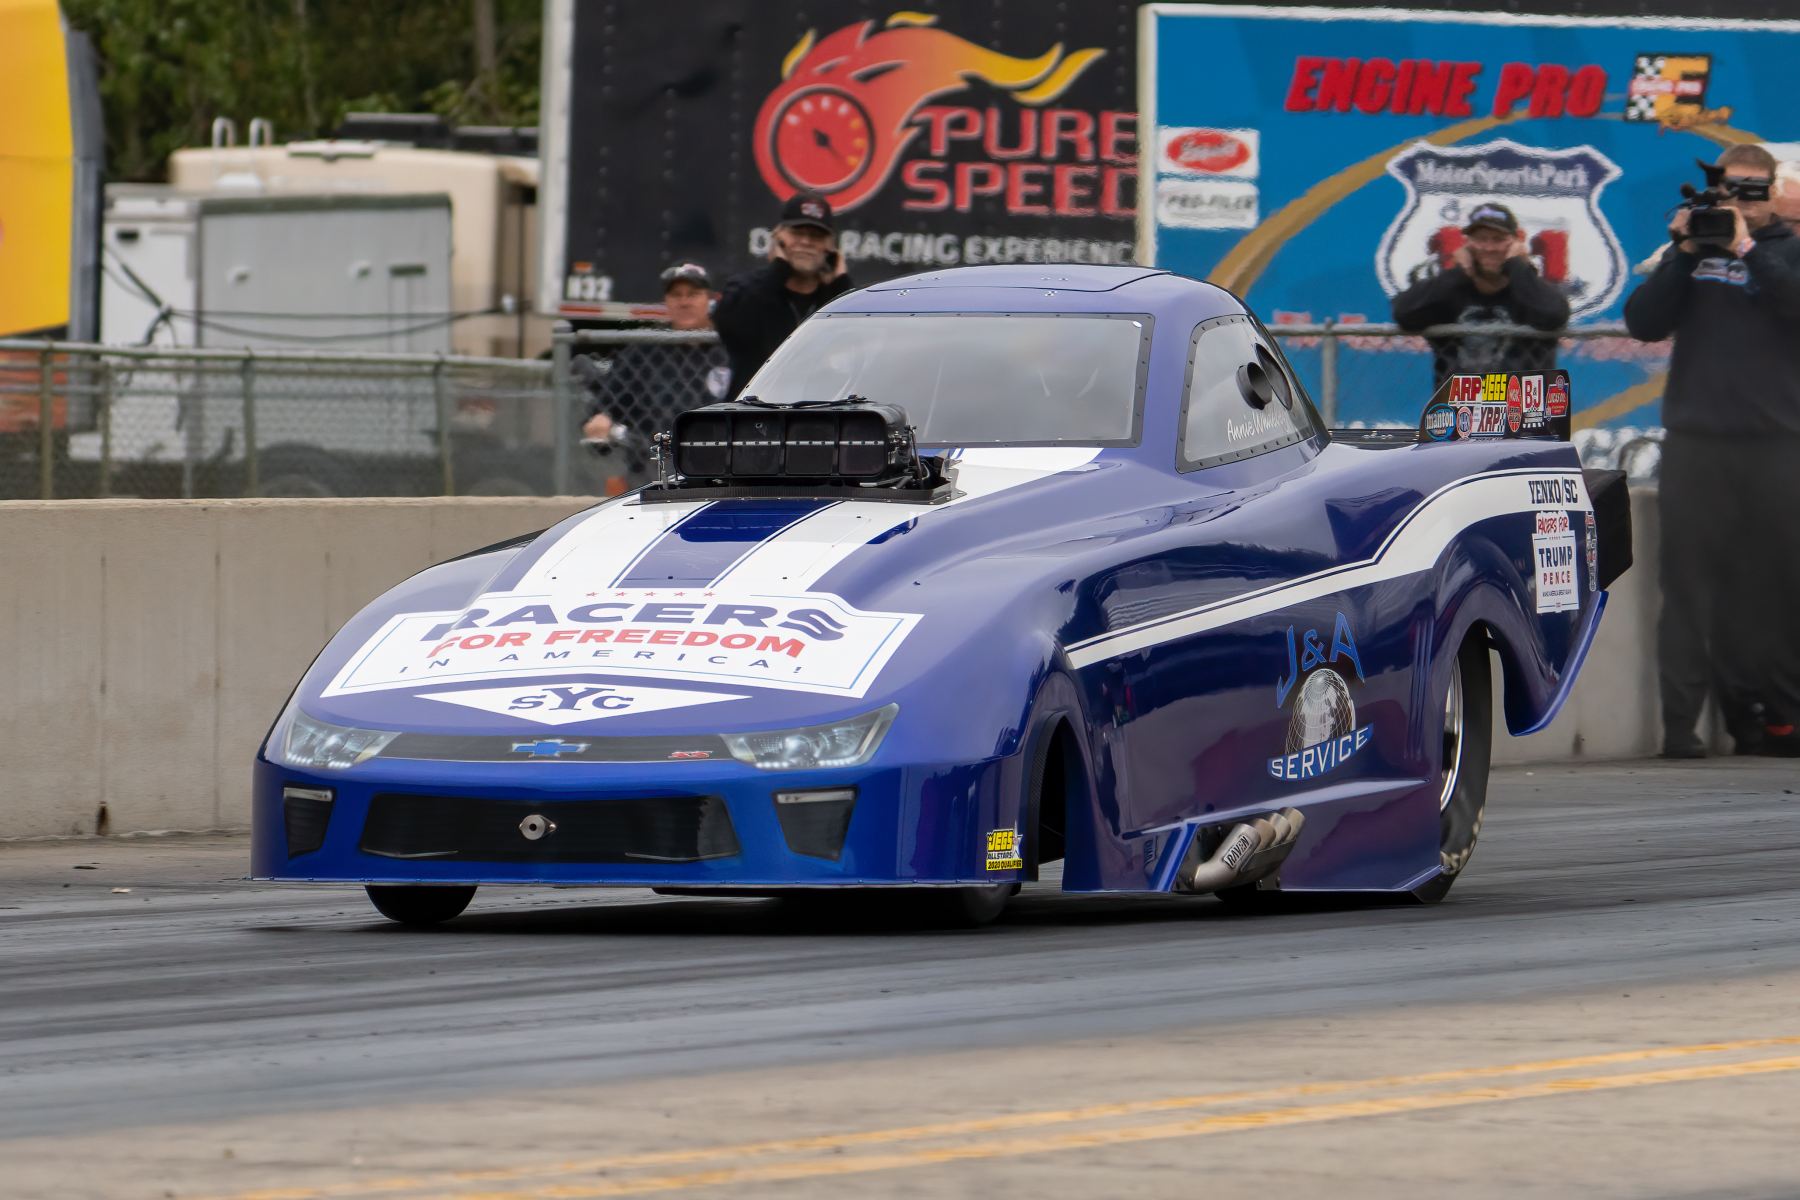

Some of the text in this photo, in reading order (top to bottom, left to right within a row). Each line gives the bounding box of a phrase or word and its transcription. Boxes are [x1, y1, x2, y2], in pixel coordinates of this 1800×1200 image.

[1284, 57, 1608, 119] ENGINE PRO
[912, 107, 1136, 163] PURE
[840, 231, 1135, 265] RACING EXPERIENC
[1428, 224, 1568, 284] 11
[1450, 377, 1482, 401] ARP
[1482, 374, 1507, 401] JEGS
[1478, 406, 1501, 432] XRP
[1528, 477, 1578, 506] YENKO/SC
[1538, 546, 1572, 568] TRUMP
[1543, 571, 1571, 585] PENCE
[420, 602, 847, 642] RACERS
[426, 628, 806, 659] FOR FREEDOM
[400, 648, 803, 675] IN AMERICA!
[1276, 611, 1366, 709] J&A
[509, 686, 634, 713] SYC
[1271, 727, 1369, 779] SERVICE
[988, 831, 1014, 851] JEGS
[1225, 835, 1251, 867] RAVEN
[988, 861, 1001, 870] 2020
